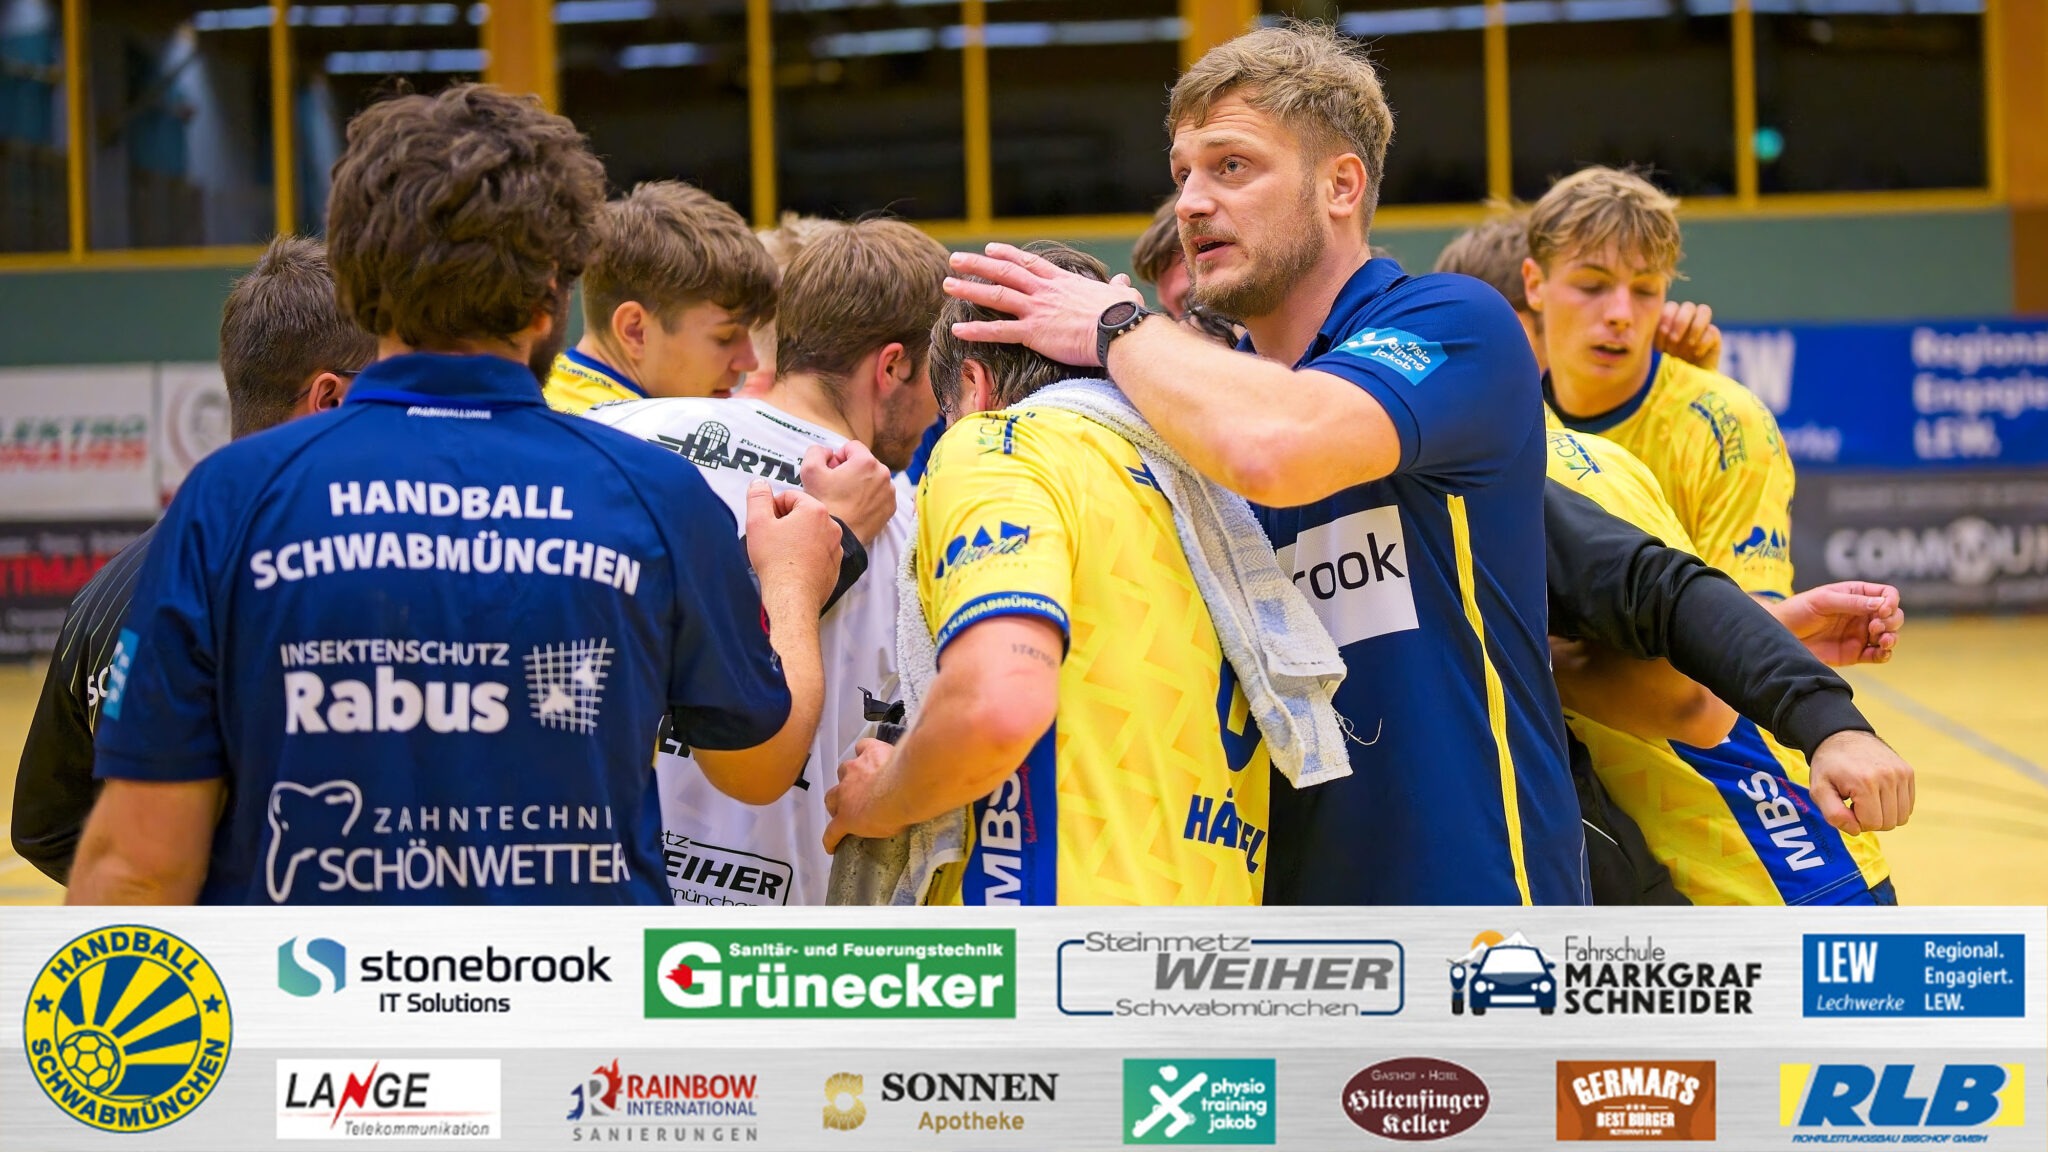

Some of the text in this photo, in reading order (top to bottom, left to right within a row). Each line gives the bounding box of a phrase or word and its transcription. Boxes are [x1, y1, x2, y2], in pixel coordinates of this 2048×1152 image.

[1371, 345, 1412, 371] jakob
[329, 480, 573, 520] HANDBALL
[250, 530, 641, 596] SCHWABMÜNCHEN
[279, 638, 510, 667] INSEKTENSCHUTZ
[283, 665, 510, 734] Rabus
[980, 771, 1022, 906] MBS
[1738, 771, 1825, 872] MBS
[319, 839, 631, 891] SCHÖNWETTER
